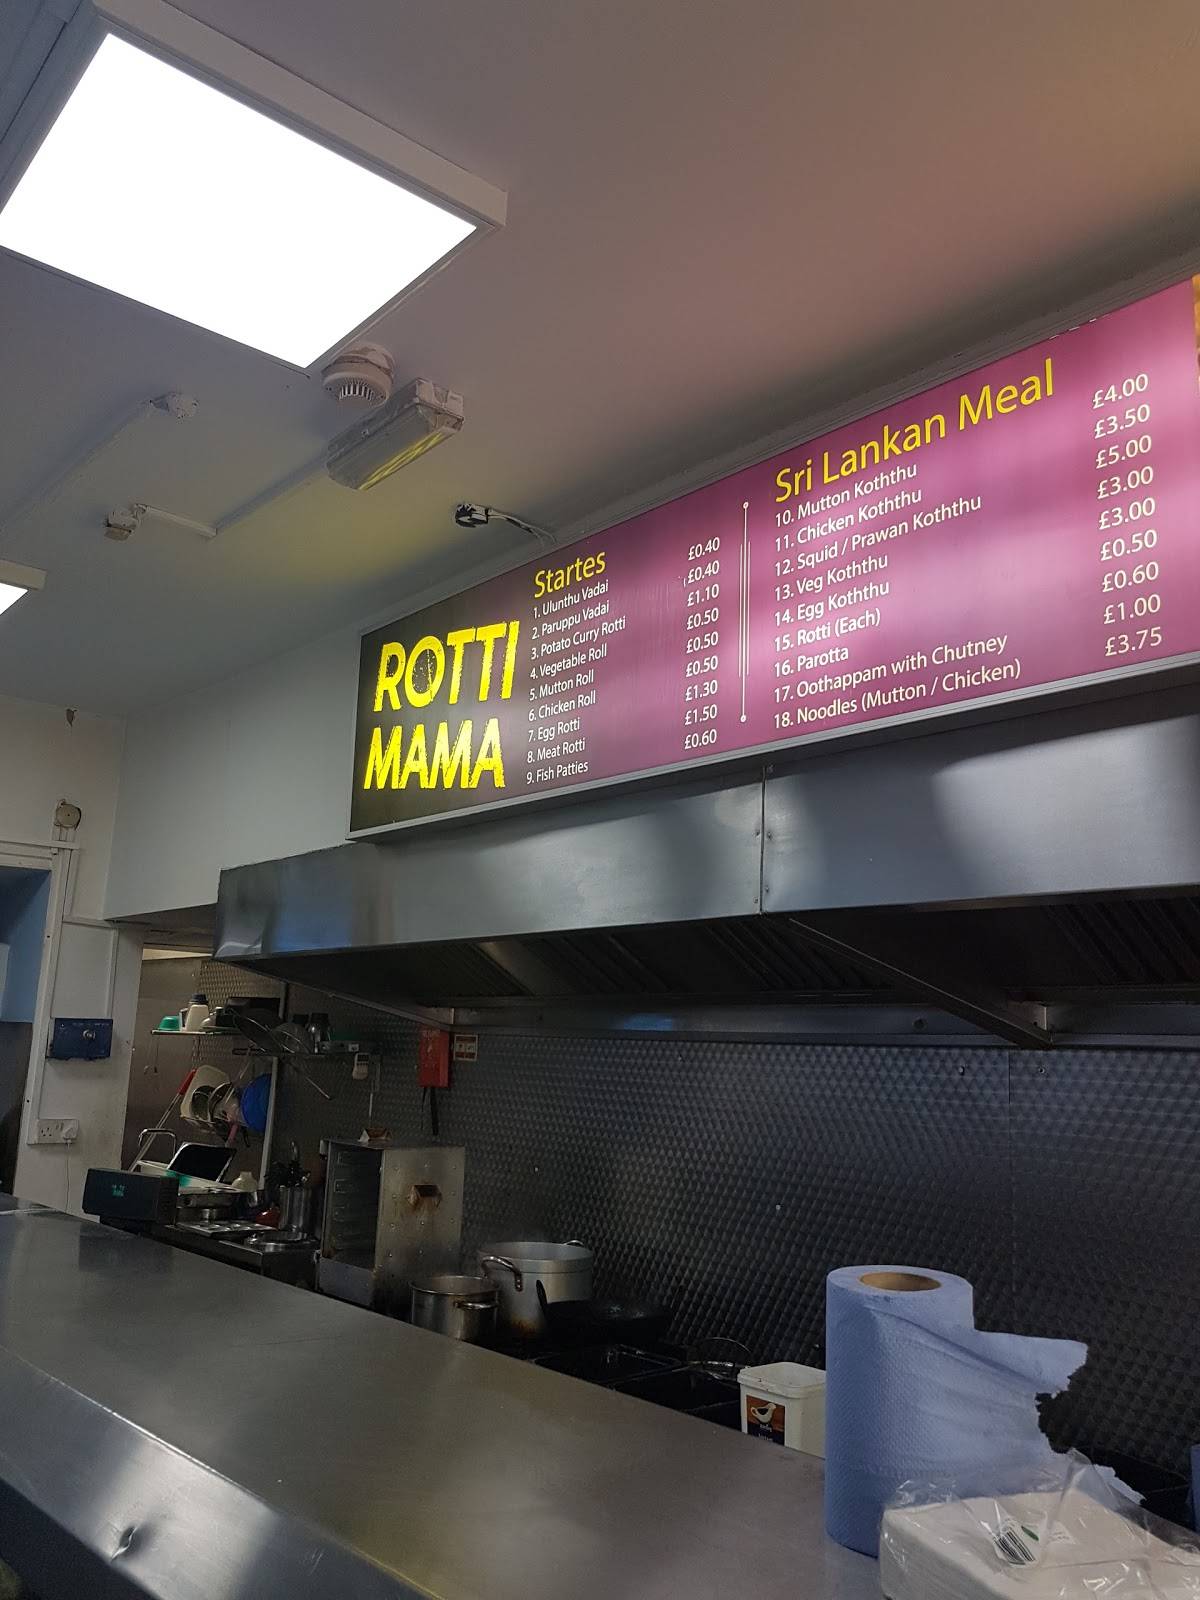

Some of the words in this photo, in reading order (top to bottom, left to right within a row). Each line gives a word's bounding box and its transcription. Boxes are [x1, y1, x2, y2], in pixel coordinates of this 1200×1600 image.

[1093, 373, 1149, 409] £4.00
[775, 459, 812, 502] Sri
[823, 413, 946, 484] Lankan
[958, 358, 1055, 430] Meal
[1094, 404, 1151, 439] £3.50
[1095, 435, 1152, 469] £5.00
[775, 510, 794, 527] 10.
[798, 489, 850, 520] Mutton
[854, 464, 917, 497] Koththu
[1097, 466, 1154, 500] £3.00
[775, 536, 794, 552] 11.
[798, 514, 854, 543] Chicken
[858, 489, 922, 522] Koththu
[1098, 497, 1156, 530] £3.00
[688, 537, 720, 561] £0.40
[774, 560, 794, 577] 12.
[798, 540, 838, 572] Squid
[841, 538, 848, 556] /
[852, 521, 908, 551] Prawan
[913, 496, 981, 530] Koththu
[1100, 529, 1158, 562] £0.50
[534, 552, 606, 598] Startes
[687, 561, 720, 584] £0.40
[774, 585, 794, 601] 13.
[797, 574, 823, 594] Veg
[827, 554, 888, 585] Koththu
[1102, 561, 1160, 593] £0.60
[534, 607, 540, 619] 1.
[542, 593, 580, 615] Ulunthu
[581, 579, 609, 600] Vadai
[687, 584, 720, 607] £1.10
[774, 610, 794, 626] 14.
[797, 600, 825, 621] Egg
[828, 580, 890, 611] Koththu
[1103, 594, 1161, 625] £1.00
[532, 627, 540, 639] 2.
[542, 614, 581, 636] Paruppu
[582, 600, 609, 621] Vadai
[687, 608, 719, 631] £0.50
[774, 636, 794, 652] 15.
[798, 621, 831, 647] Rotti
[835, 608, 881, 636] (Each)
[531, 648, 539, 660] 3.
[541, 638, 570, 656] Potato
[572, 628, 600, 645] Curry
[601, 616, 626, 636] Rotti
[686, 632, 719, 654] £0.50
[1104, 627, 1163, 657] £3.75
[373, 620, 520, 712] ROTTI
[530, 668, 538, 679] 4.
[540, 652, 586, 677] Vegetable
[588, 643, 607, 662] Roll
[686, 656, 719, 677] £0.50
[774, 661, 794, 677] 16.
[797, 646, 849, 672] Parotta
[774, 687, 794, 702] 17.
[797, 664, 887, 697] Oothappam
[891, 652, 928, 675] with
[932, 634, 1008, 665] Chutney
[529, 688, 537, 701] 5.
[539, 679, 574, 698] Mutton
[576, 669, 594, 686] Roll
[685, 680, 718, 701] £1.30
[774, 712, 794, 729] 18.
[797, 698, 858, 724] Noodles
[862, 682, 926, 712] (Mutton
[930, 677, 939, 696] /
[942, 658, 1021, 693] Chicken)
[528, 709, 537, 721] 6.
[538, 699, 575, 718] Chicken
[577, 690, 596, 707] Roll
[684, 705, 717, 726] £1.50
[528, 730, 536, 742] 7.
[538, 726, 555, 741] Egg
[557, 717, 580, 735] Rotti
[684, 729, 717, 750] £0.60
[364, 718, 505, 789] MAMA
[527, 751, 535, 763] 8.
[537, 745, 560, 761] Meat
[562, 737, 585, 755] Rotti
[526, 772, 534, 784] 9.
[536, 766, 554, 782] Fish
[556, 760, 588, 778] Patties
